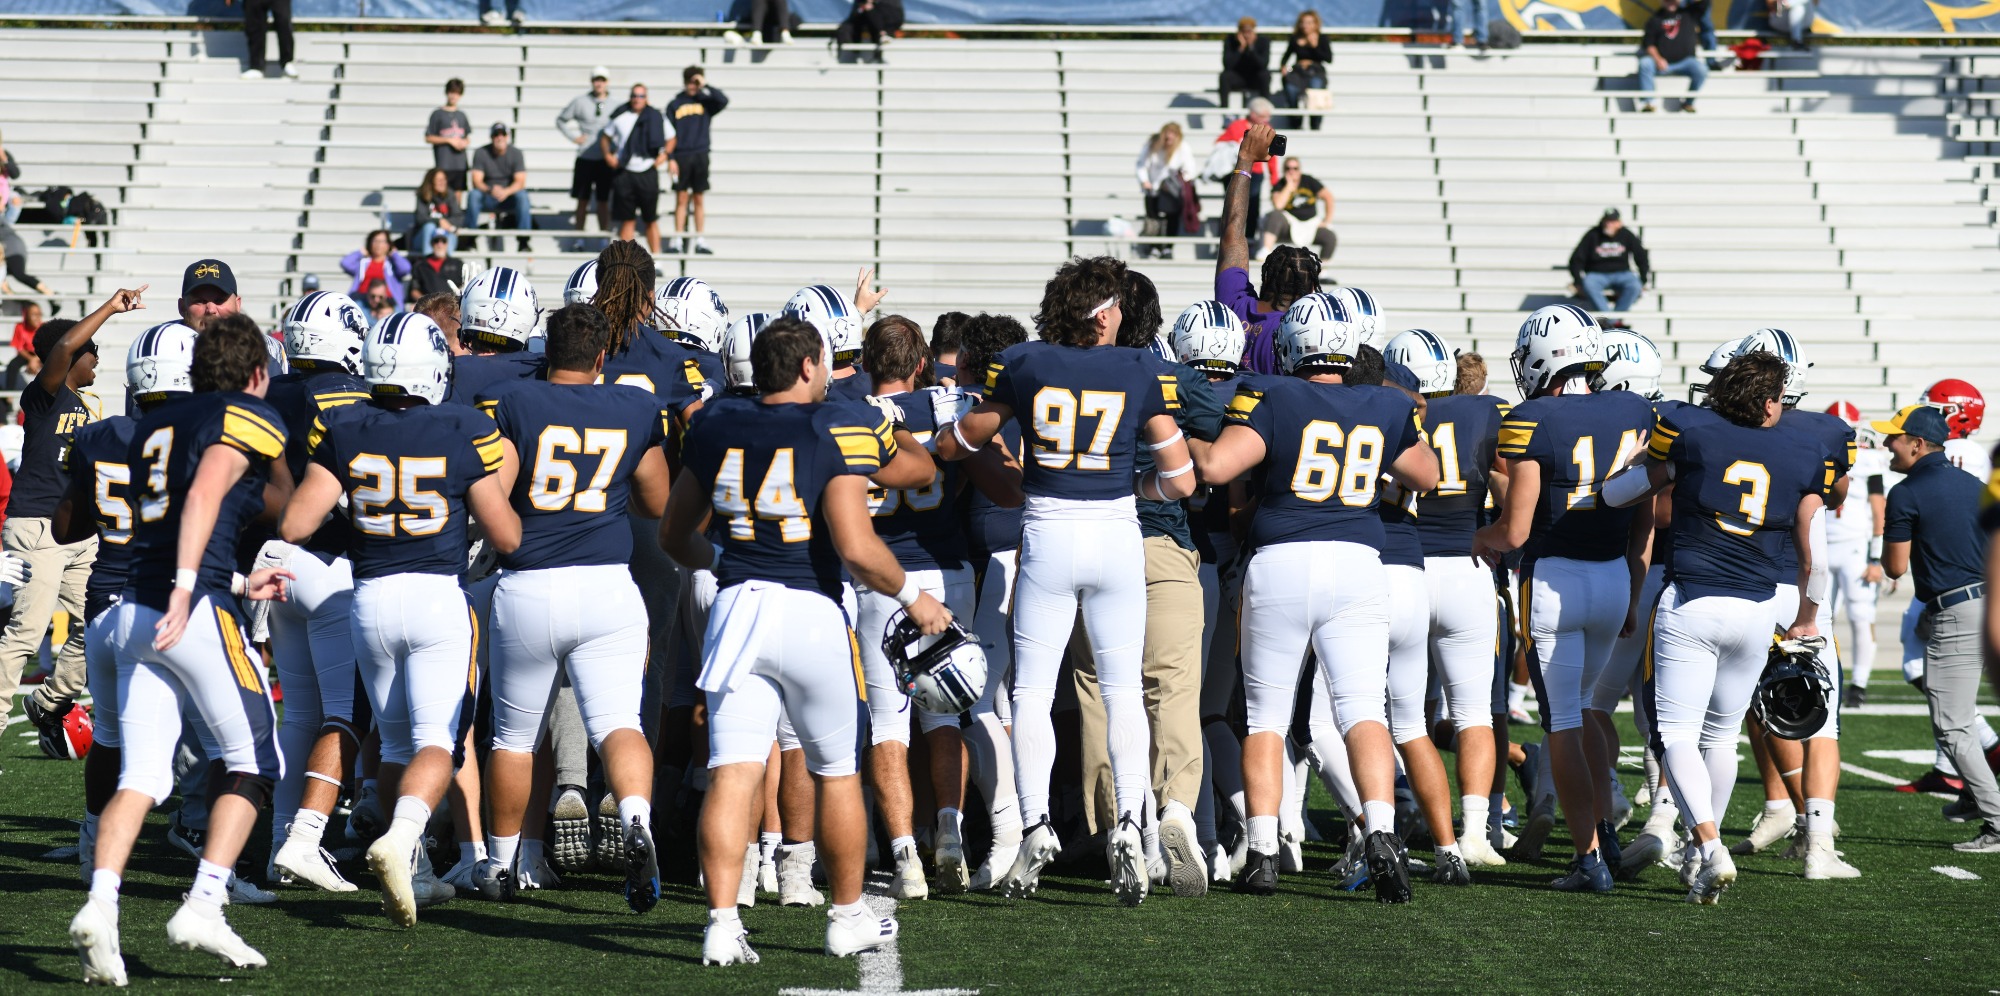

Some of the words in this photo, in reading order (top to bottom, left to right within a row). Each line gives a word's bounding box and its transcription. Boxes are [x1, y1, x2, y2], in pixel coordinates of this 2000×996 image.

[1284, 304, 1314, 325] CNJ
[1521, 316, 1552, 338] CNJ
[835, 350, 854, 361] ONS
[1192, 348, 1200, 357] 37
[1326, 353, 1347, 363] LIONS
[1575, 345, 1583, 354] 14
[1605, 342, 1641, 364] CNJ
[1206, 359, 1227, 368] LIONS
[376, 385, 401, 394] LIONS
[1779, 396, 1798, 405] dell
[1032, 386, 1126, 471] 97
[140, 426, 174, 522] 3
[528, 424, 628, 512] 67
[1290, 419, 1385, 508] 68
[349, 452, 449, 536] 25
[712, 447, 813, 543] 44
[1715, 459, 1771, 537] 3
